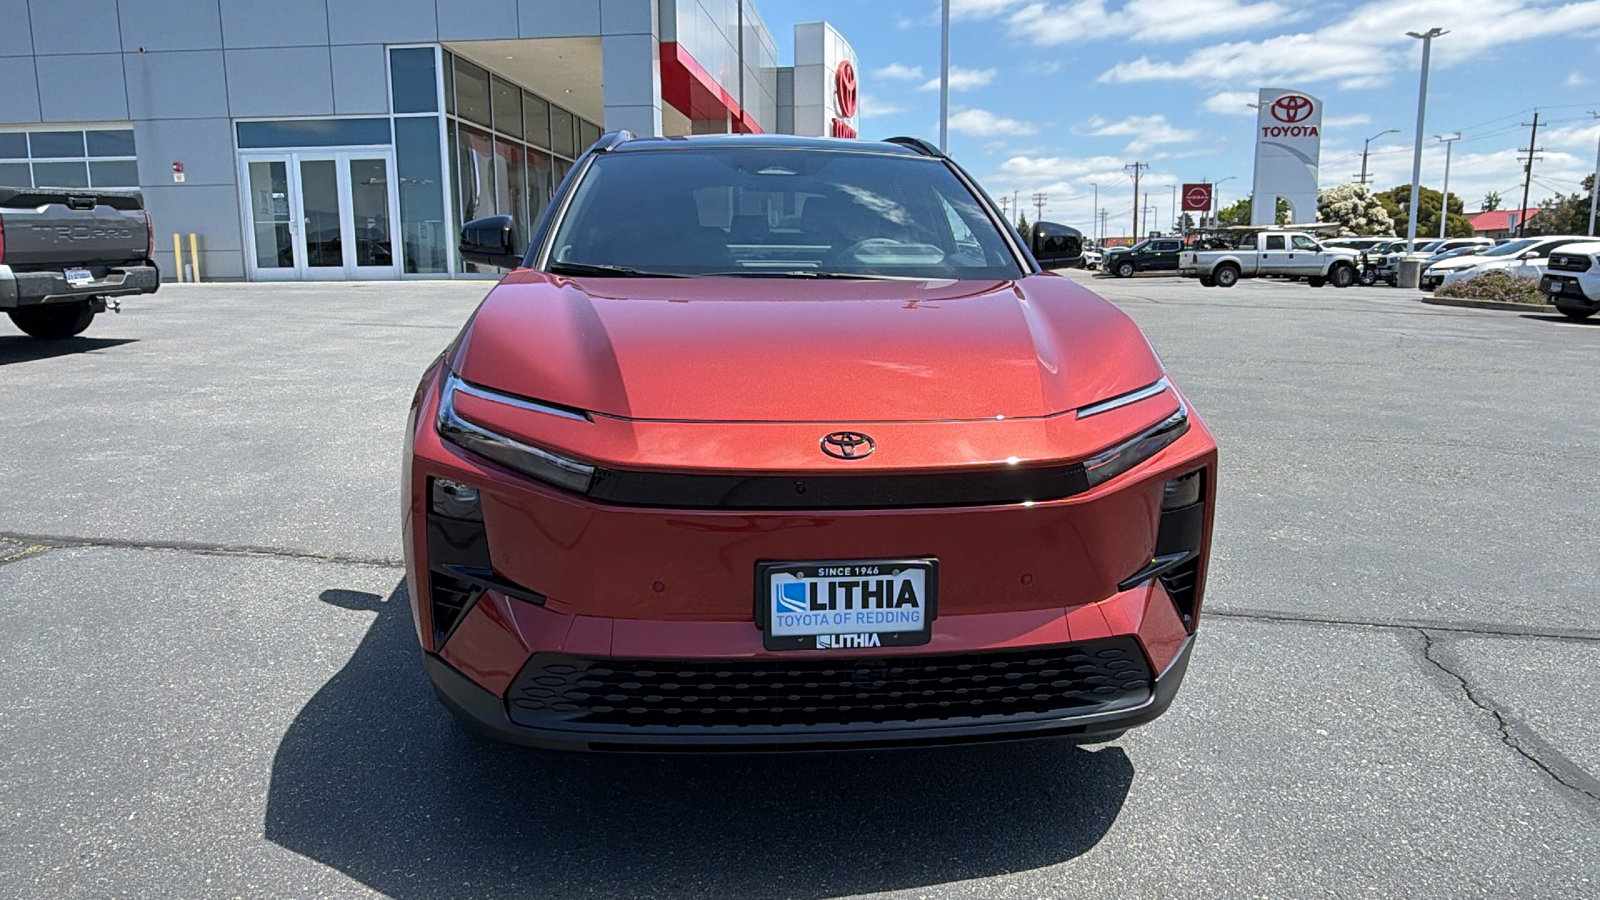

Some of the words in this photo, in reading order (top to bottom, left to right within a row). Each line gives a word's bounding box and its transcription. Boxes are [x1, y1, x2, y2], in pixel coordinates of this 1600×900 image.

[1261, 126, 1319, 138] TOYOTA
[32, 225, 91, 243] TRD
[91, 229, 133, 239] PRO
[818, 568, 851, 577] SINCE
[854, 567, 879, 576] 1946
[809, 579, 920, 612] LITHIA
[776, 612, 829, 628] TOYOTA
[835, 612, 851, 625] OF
[856, 611, 920, 625] REDDING
[831, 633, 881, 649] LITHIA
